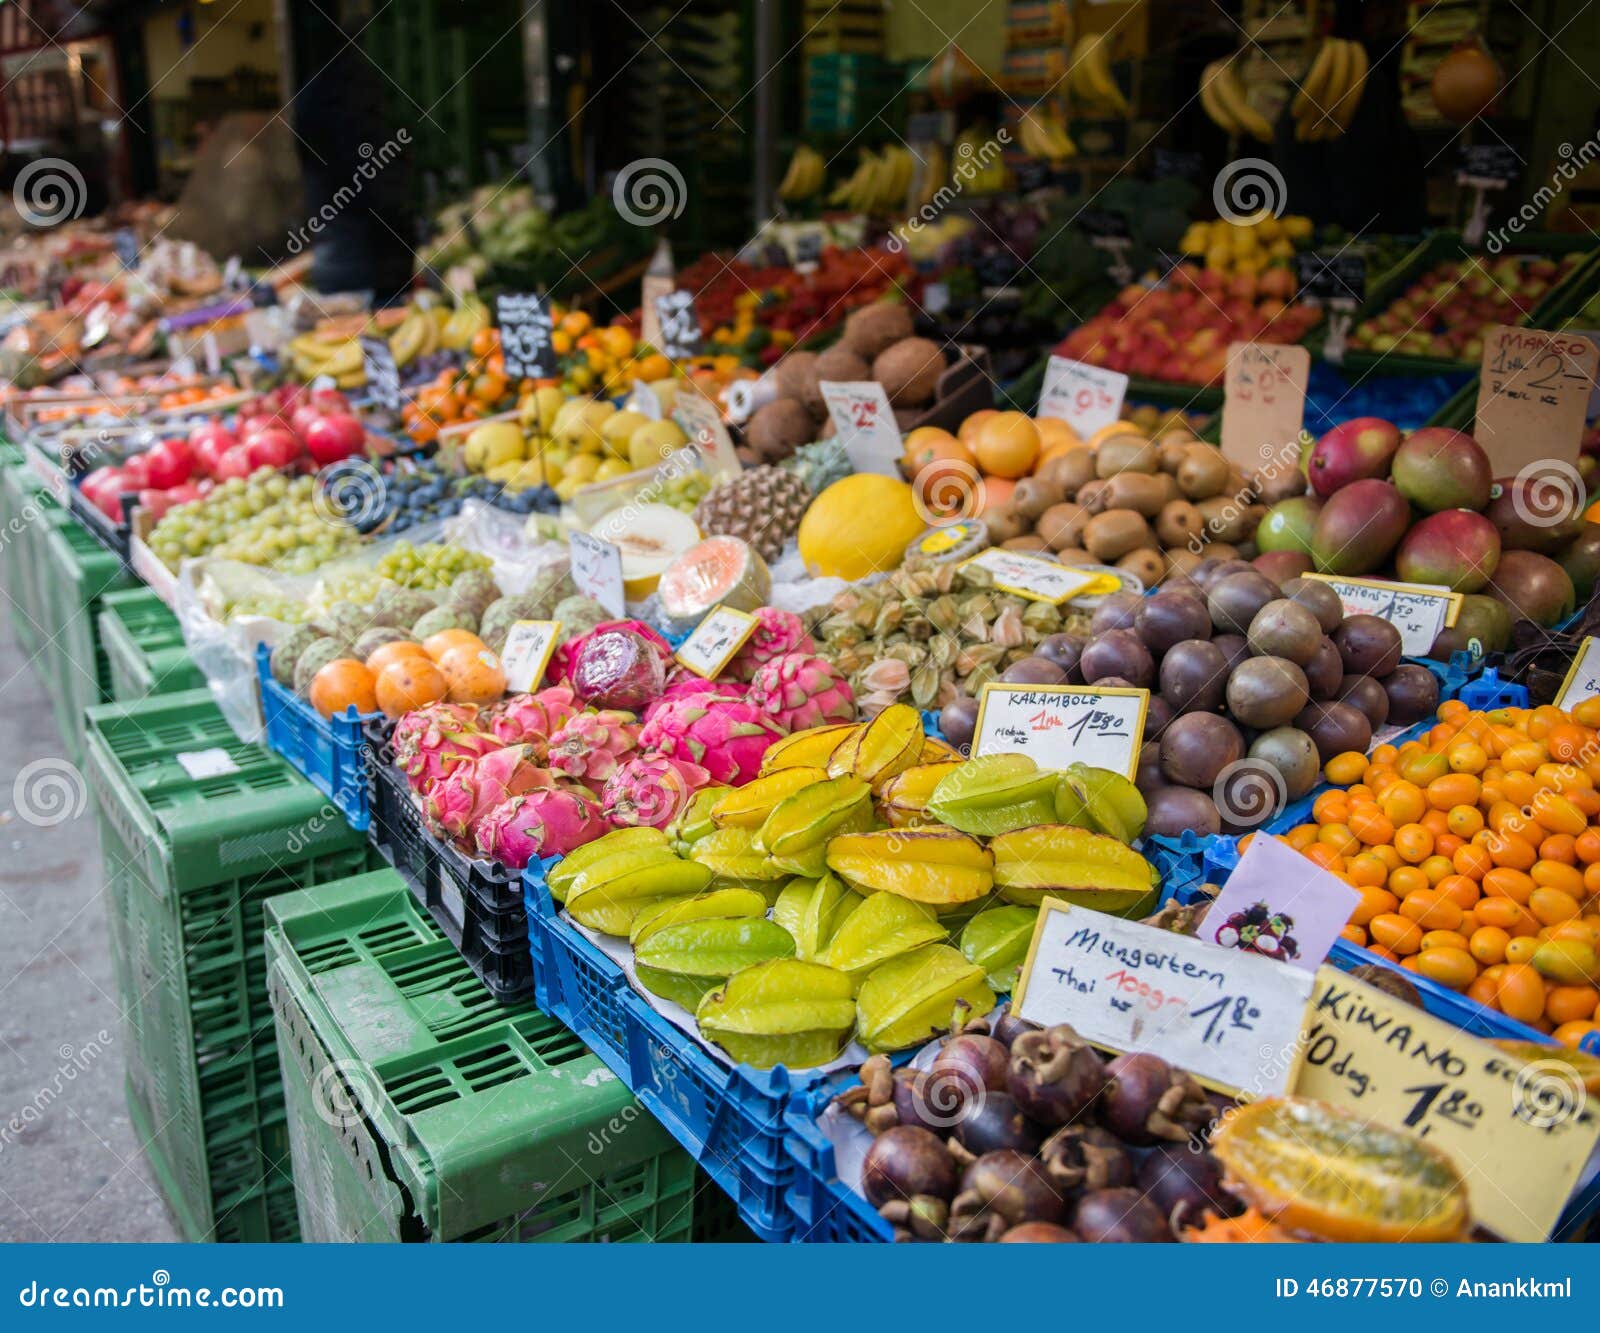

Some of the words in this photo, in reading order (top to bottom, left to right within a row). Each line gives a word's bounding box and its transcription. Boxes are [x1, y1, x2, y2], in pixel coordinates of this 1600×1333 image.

[1500, 334, 1586, 355] MANGO
[1008, 692, 1102, 708] KARAMBOLE
[1051, 966, 1097, 994] Thai
